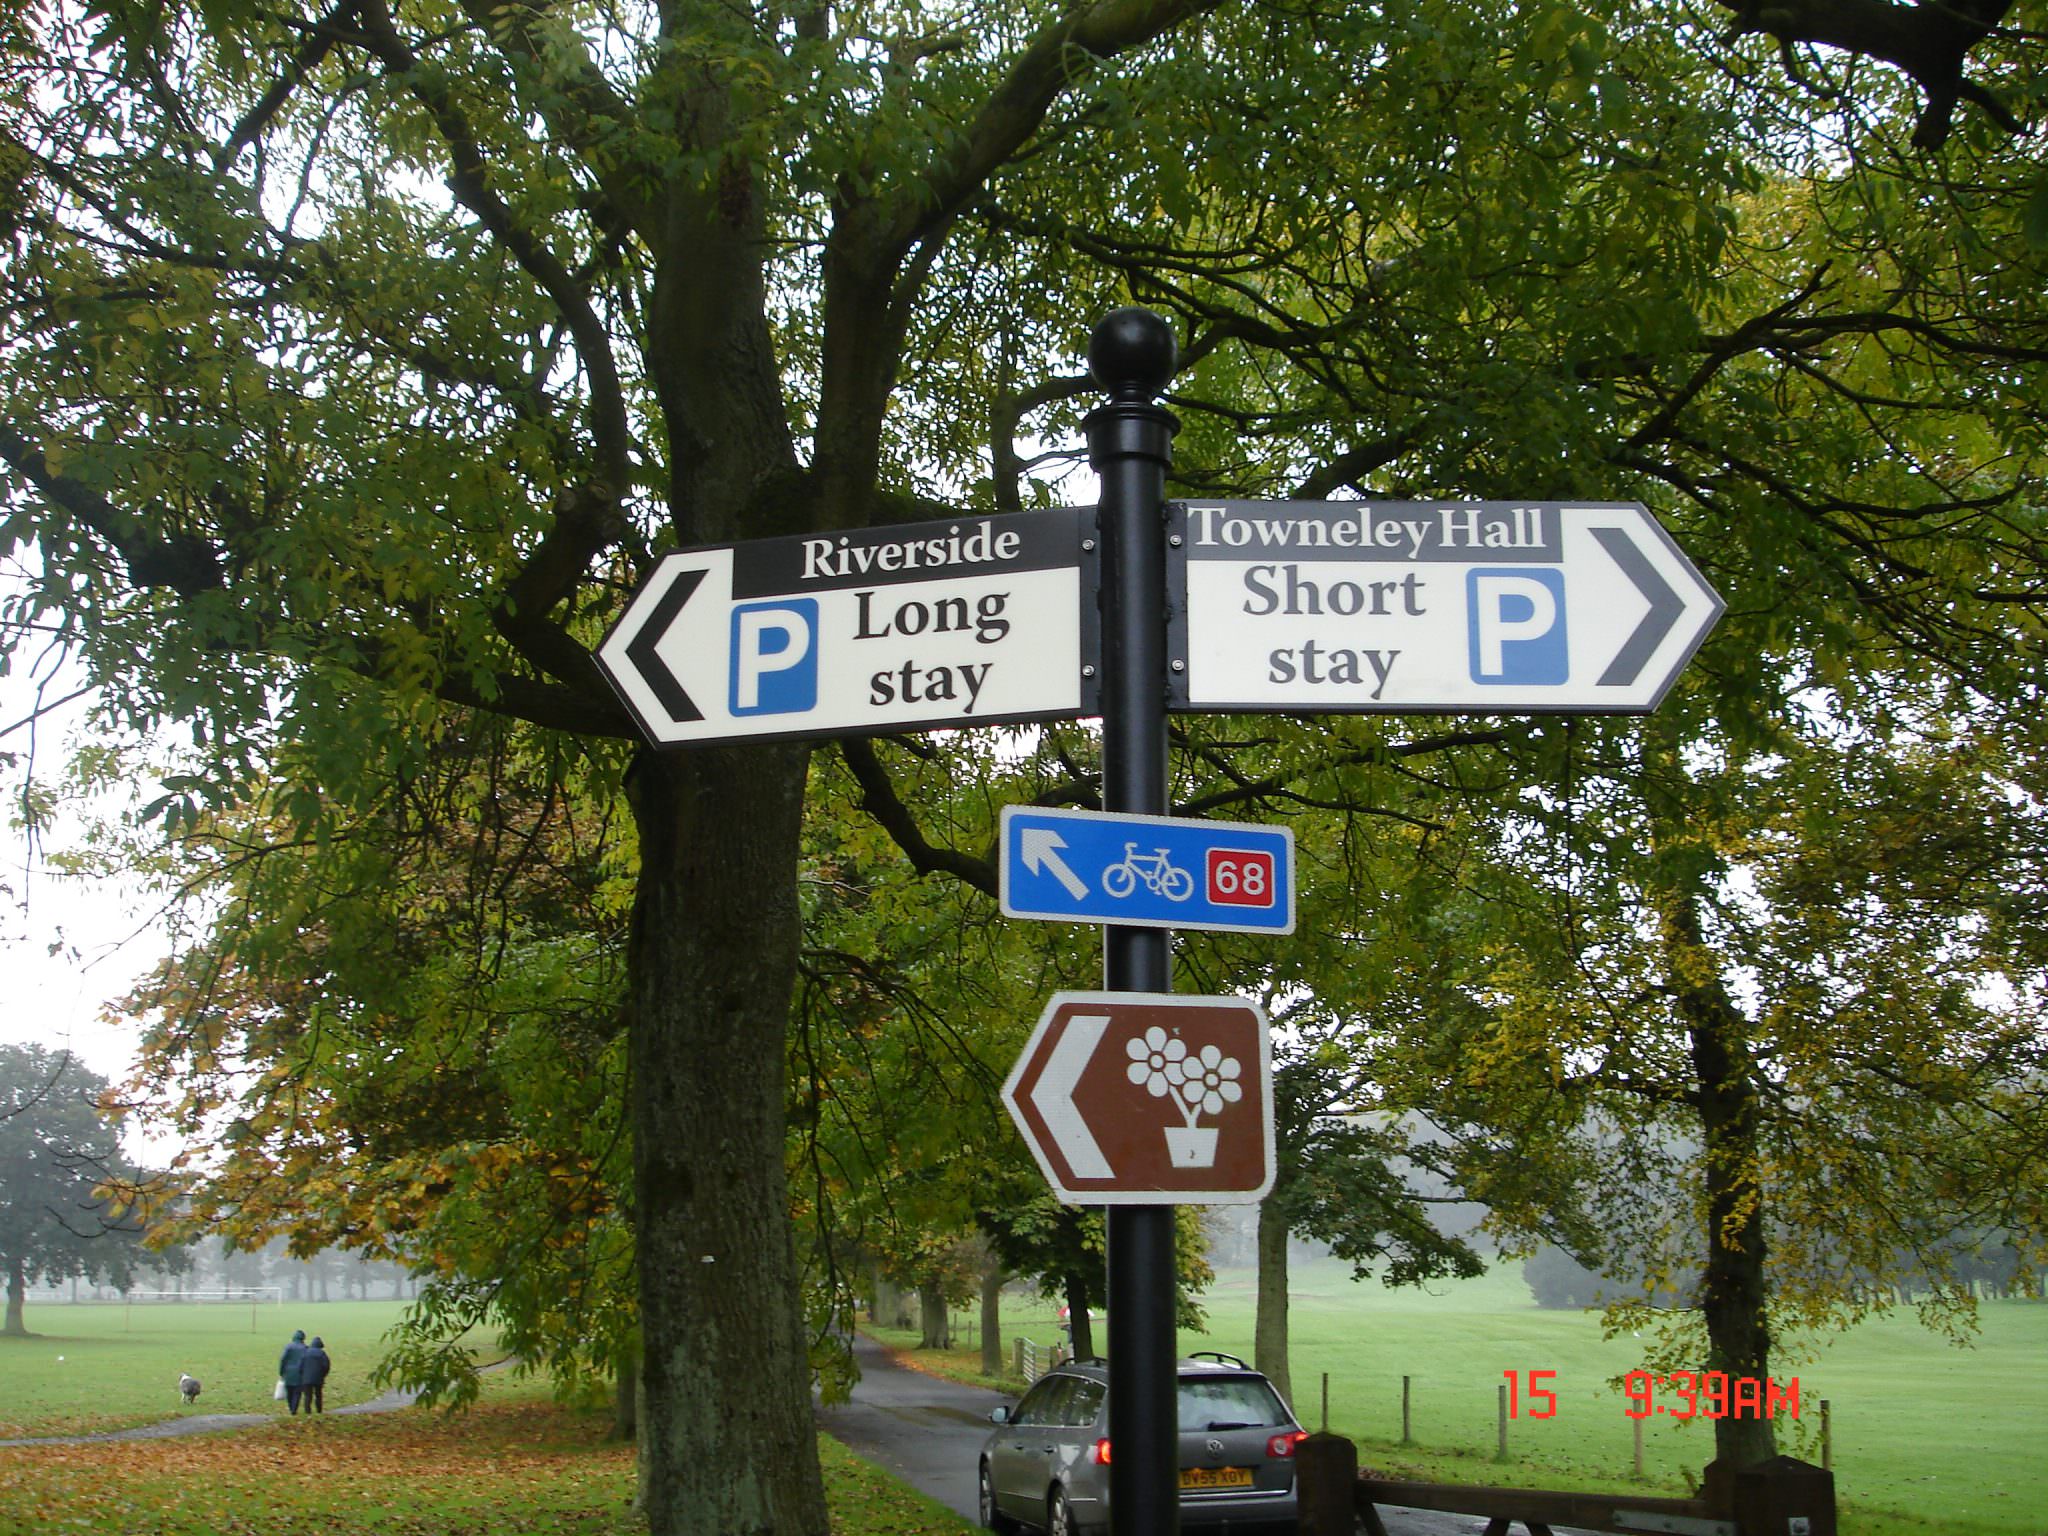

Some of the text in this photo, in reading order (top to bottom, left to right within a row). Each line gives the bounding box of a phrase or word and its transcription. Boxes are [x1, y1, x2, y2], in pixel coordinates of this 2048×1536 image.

[801, 521, 1020, 580] Riverside
[1188, 507, 1547, 559] Towneley Hall
[853, 590, 1011, 644] Long
[1242, 565, 1426, 616] Short
[1476, 576, 1556, 676] P
[737, 609, 810, 708] P
[1268, 639, 1401, 700] stay
[869, 659, 993, 713] stay
[1215, 860, 1265, 896] 68
